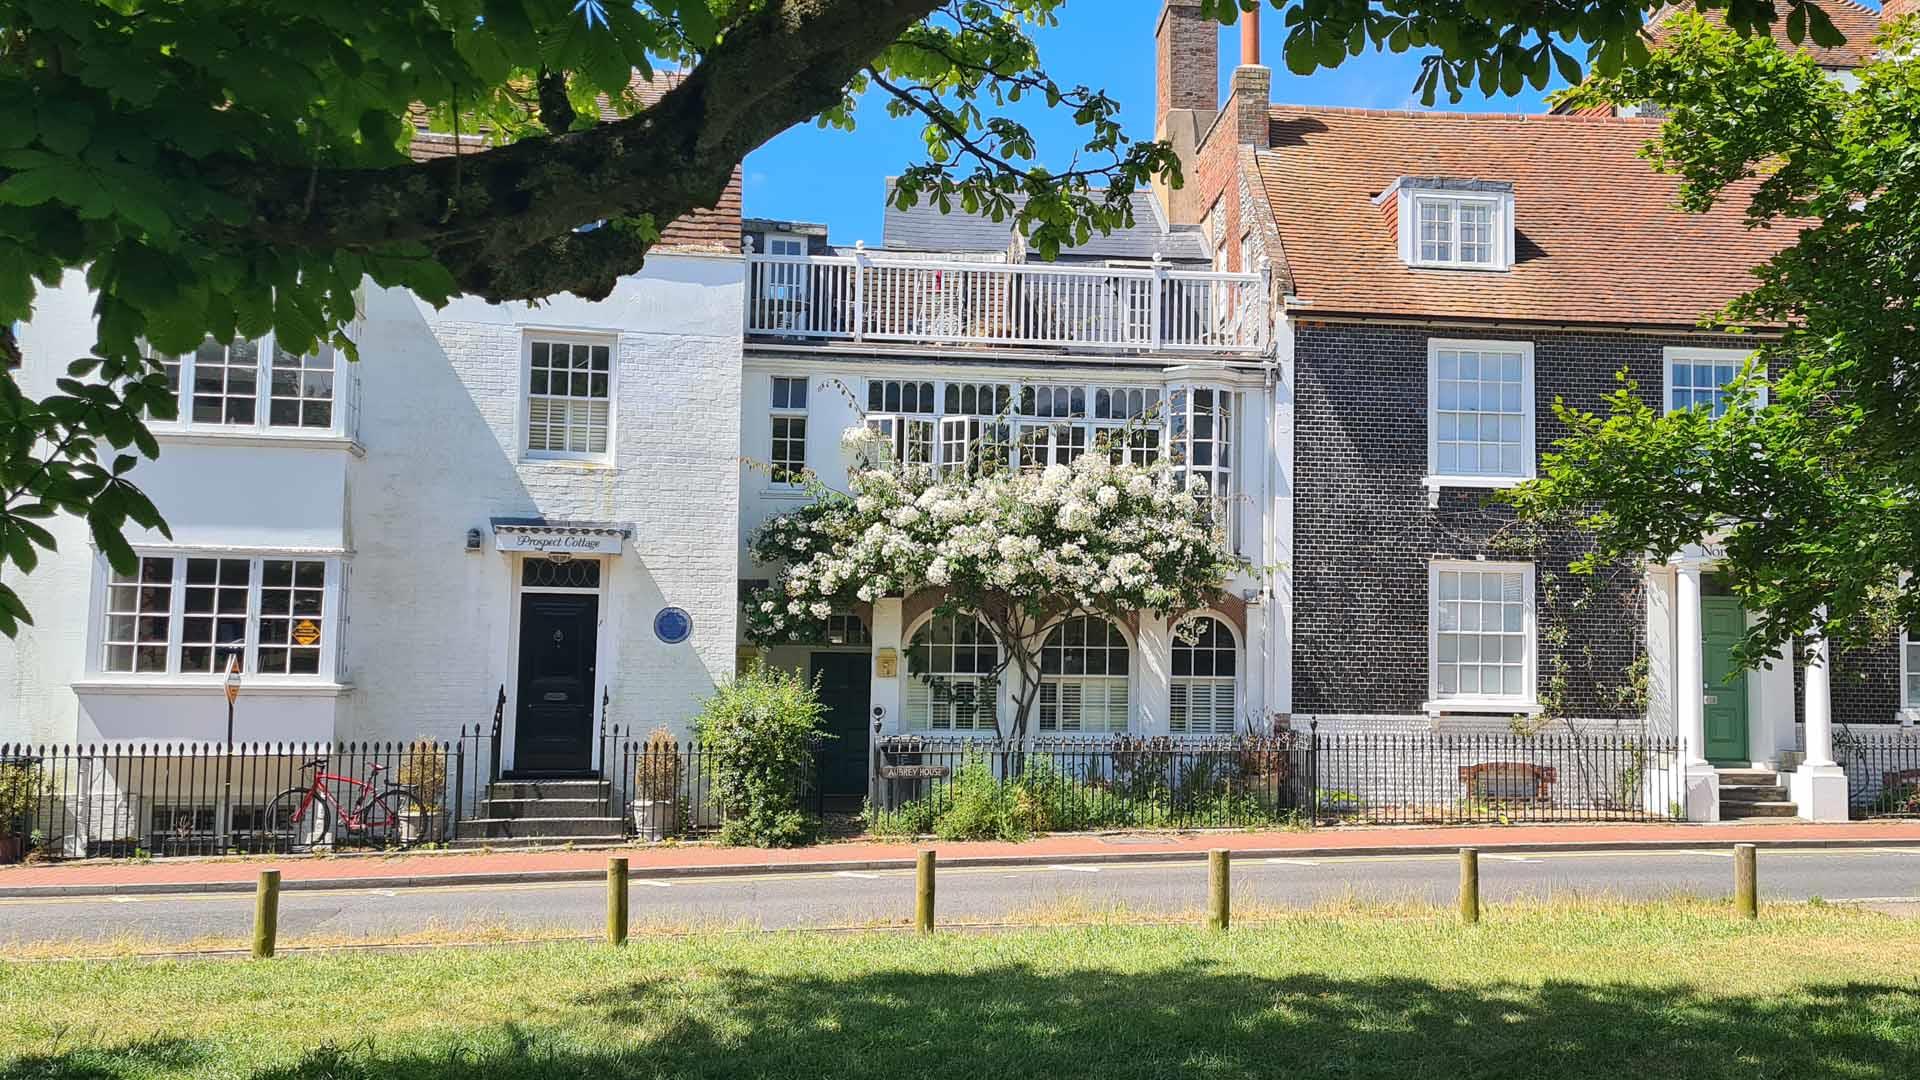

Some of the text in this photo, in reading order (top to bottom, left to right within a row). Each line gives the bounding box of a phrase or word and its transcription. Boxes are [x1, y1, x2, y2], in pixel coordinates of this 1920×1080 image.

[517, 535, 600, 551] Prospect Cottage
[1701, 544, 1728, 556] Nor
[888, 767, 942, 777] AUBREY HOUSE
